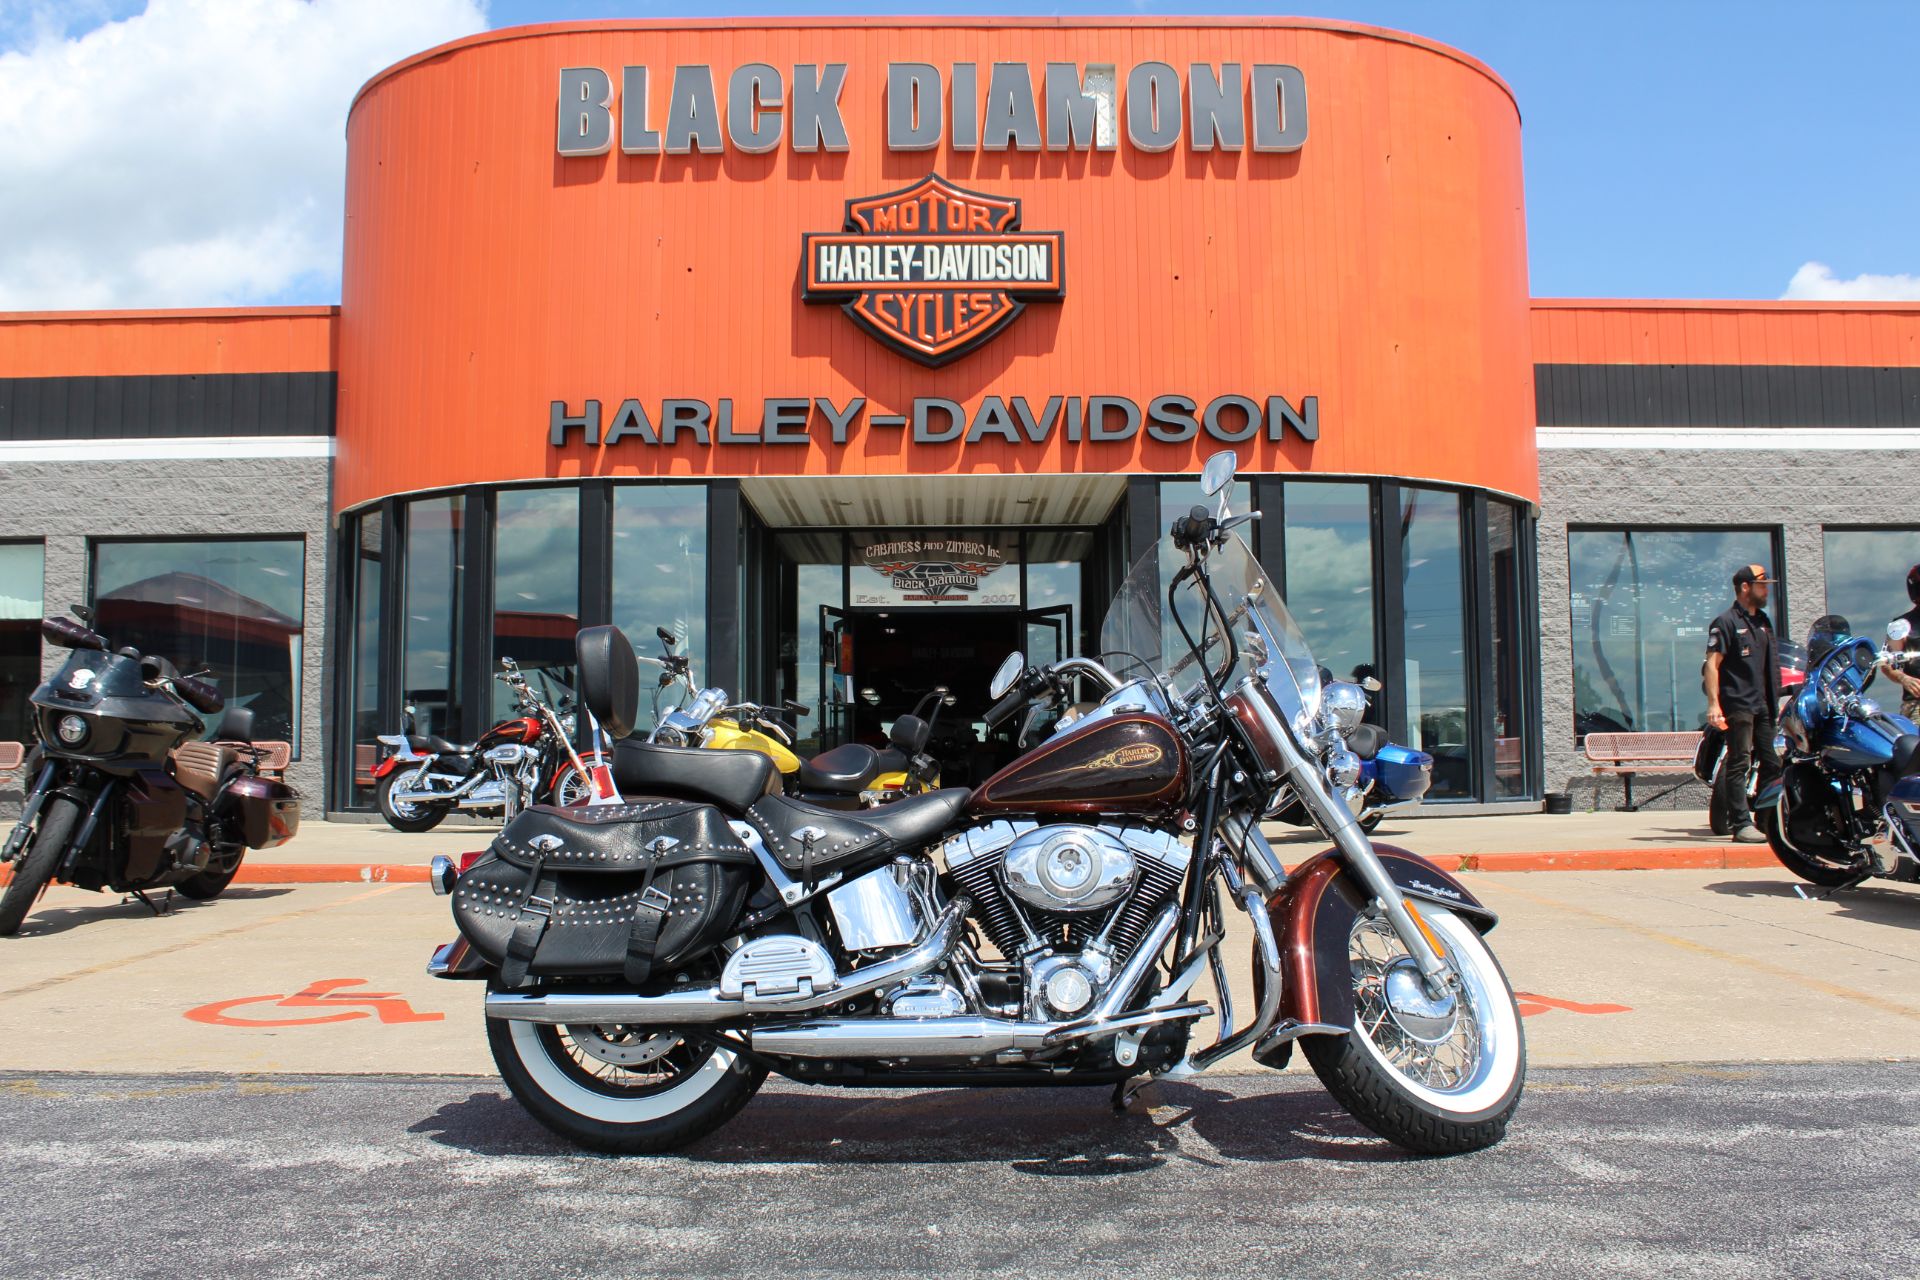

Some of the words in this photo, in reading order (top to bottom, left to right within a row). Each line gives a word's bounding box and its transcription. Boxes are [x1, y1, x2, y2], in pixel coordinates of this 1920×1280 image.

[556, 63, 850, 157] BLACK
[887, 60, 1309, 154] DIAMOND
[873, 189, 994, 232] MOTOR
[820, 244, 1048, 281] HARLEY-DAVIDSON
[875, 293, 993, 344] CYCLES
[550, 395, 1320, 446] HARLEY-DAVIDSON
[856, 594, 890, 604] Est.
[981, 593, 1016, 604] 2007
